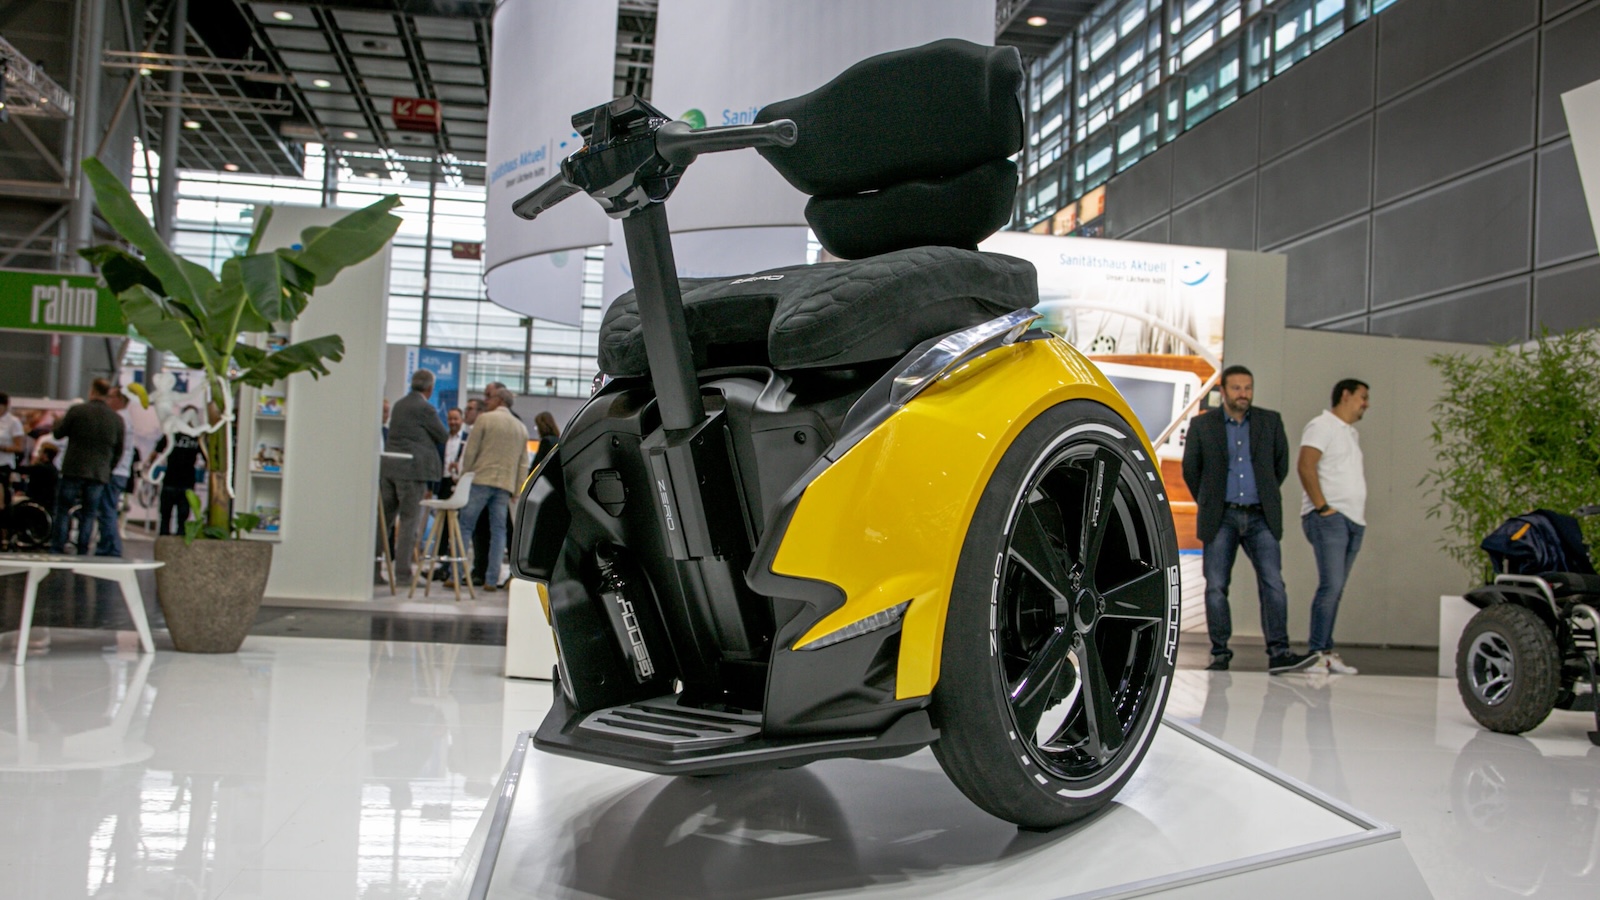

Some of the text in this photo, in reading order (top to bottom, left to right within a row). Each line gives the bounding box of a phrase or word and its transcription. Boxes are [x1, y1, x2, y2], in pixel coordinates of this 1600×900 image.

[722, 105, 760, 126] Sanit
[1059, 252, 1167, 273] Sanitätshaus Aktuell
[31, 279, 98, 327] rahm
[657, 479, 675, 531] ZERO
[989, 552, 1004, 656] ZERO
